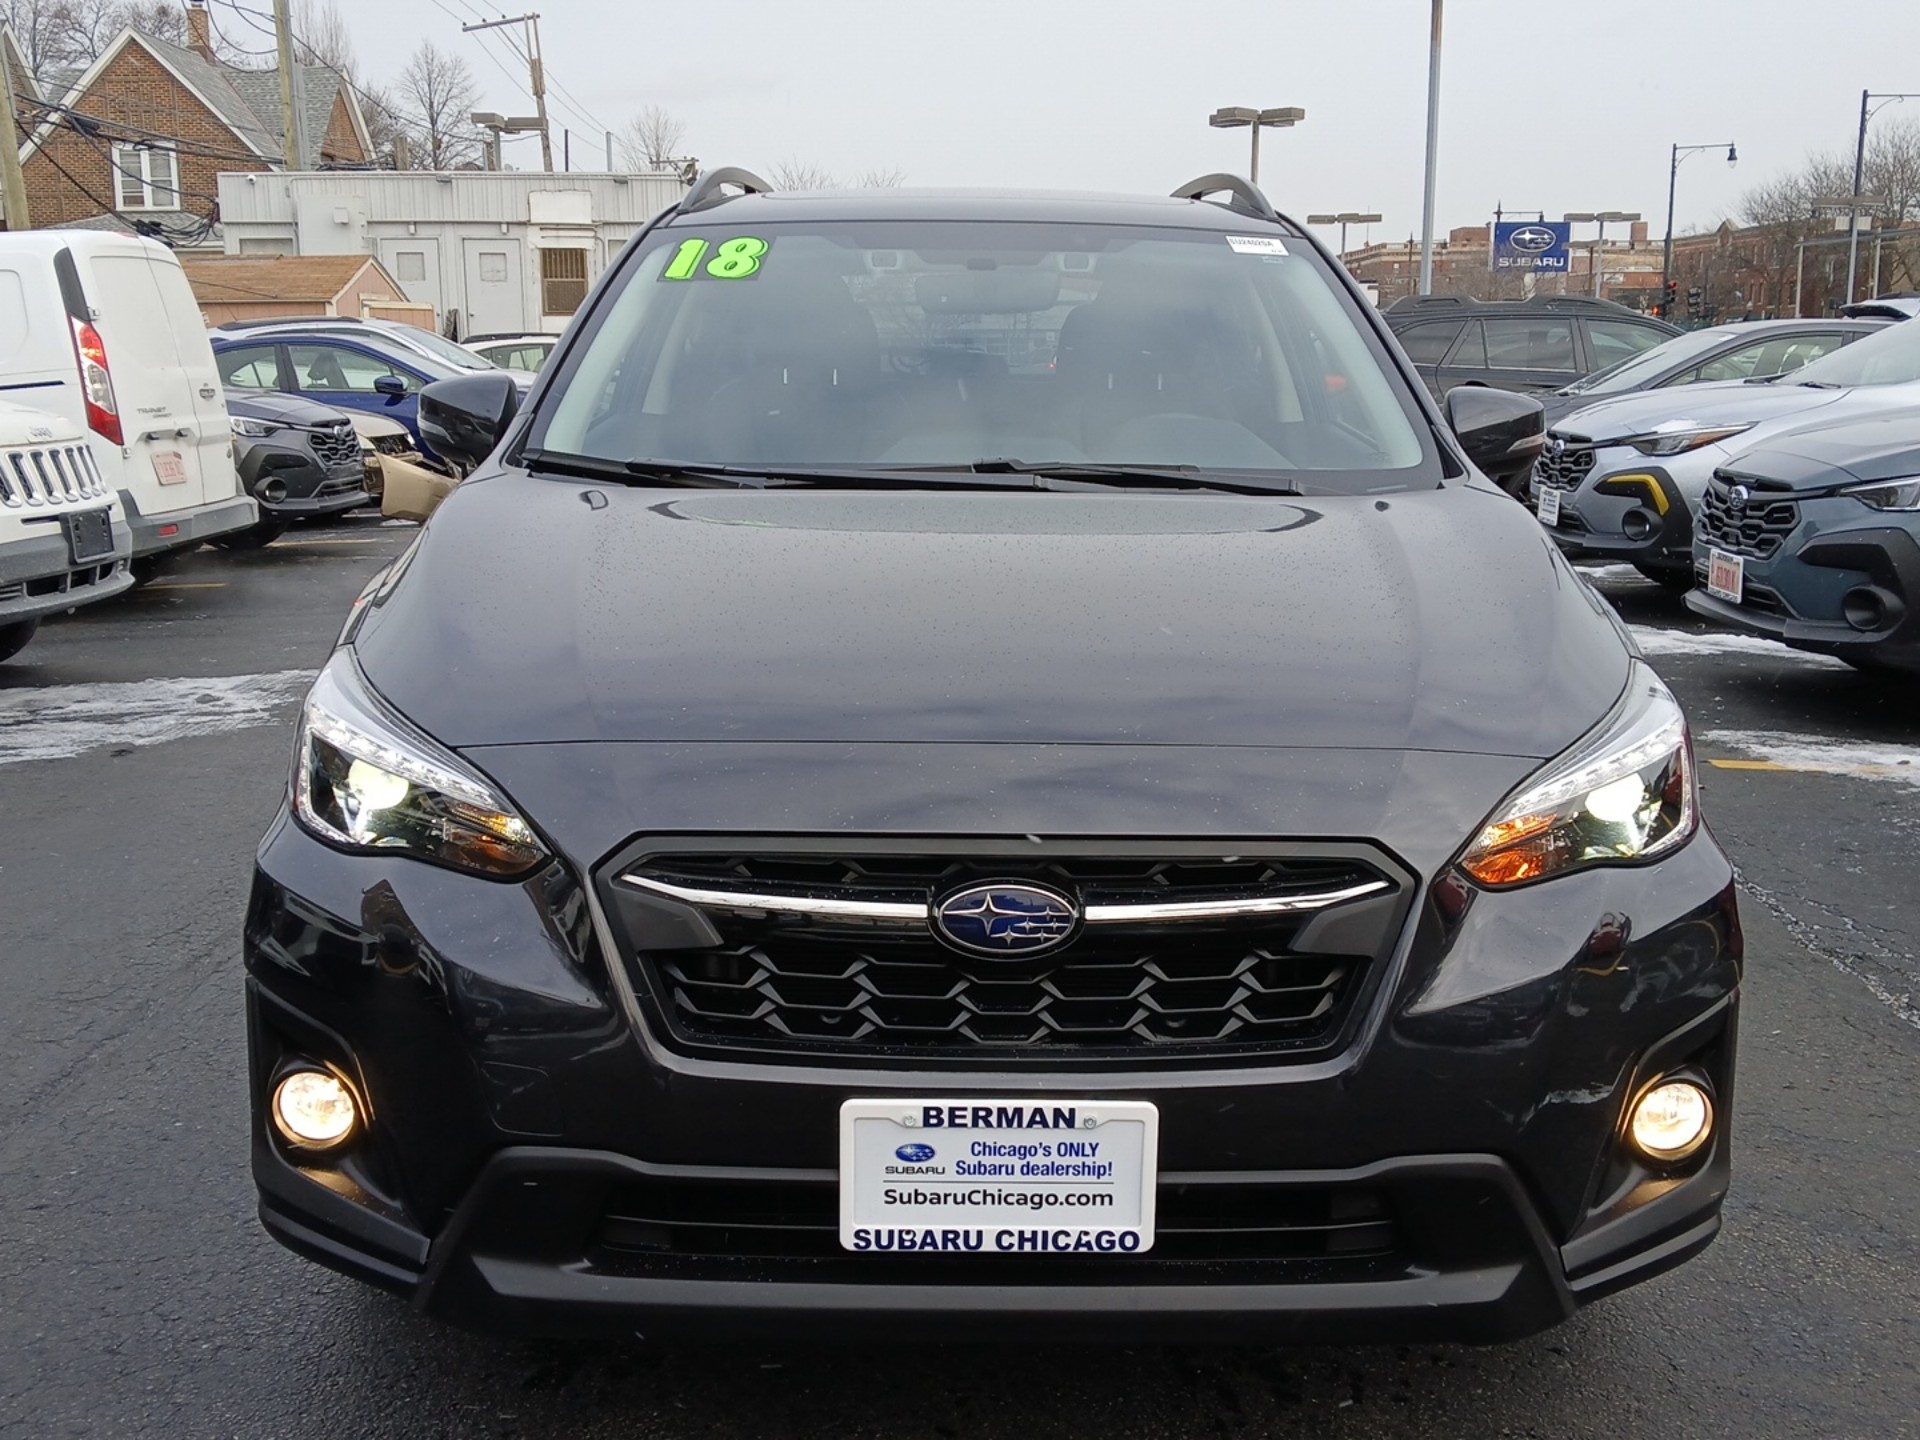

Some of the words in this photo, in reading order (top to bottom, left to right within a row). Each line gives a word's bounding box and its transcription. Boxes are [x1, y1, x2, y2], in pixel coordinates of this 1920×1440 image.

[664, 236, 769, 280] 18
[1498, 257, 1564, 267] SUBARU
[922, 1106, 1076, 1129] BERMAN
[970, 1141, 1052, 1160] Chicago's
[1056, 1142, 1100, 1158] ONLY
[885, 1165, 946, 1175] SUBARU
[955, 1160, 1015, 1177] Subaru
[1019, 1160, 1113, 1180] dealership!
[883, 1188, 1114, 1211] SubaruChicago.com
[853, 1229, 984, 1250] SUBARU
[994, 1230, 1140, 1251] CHICAGO
